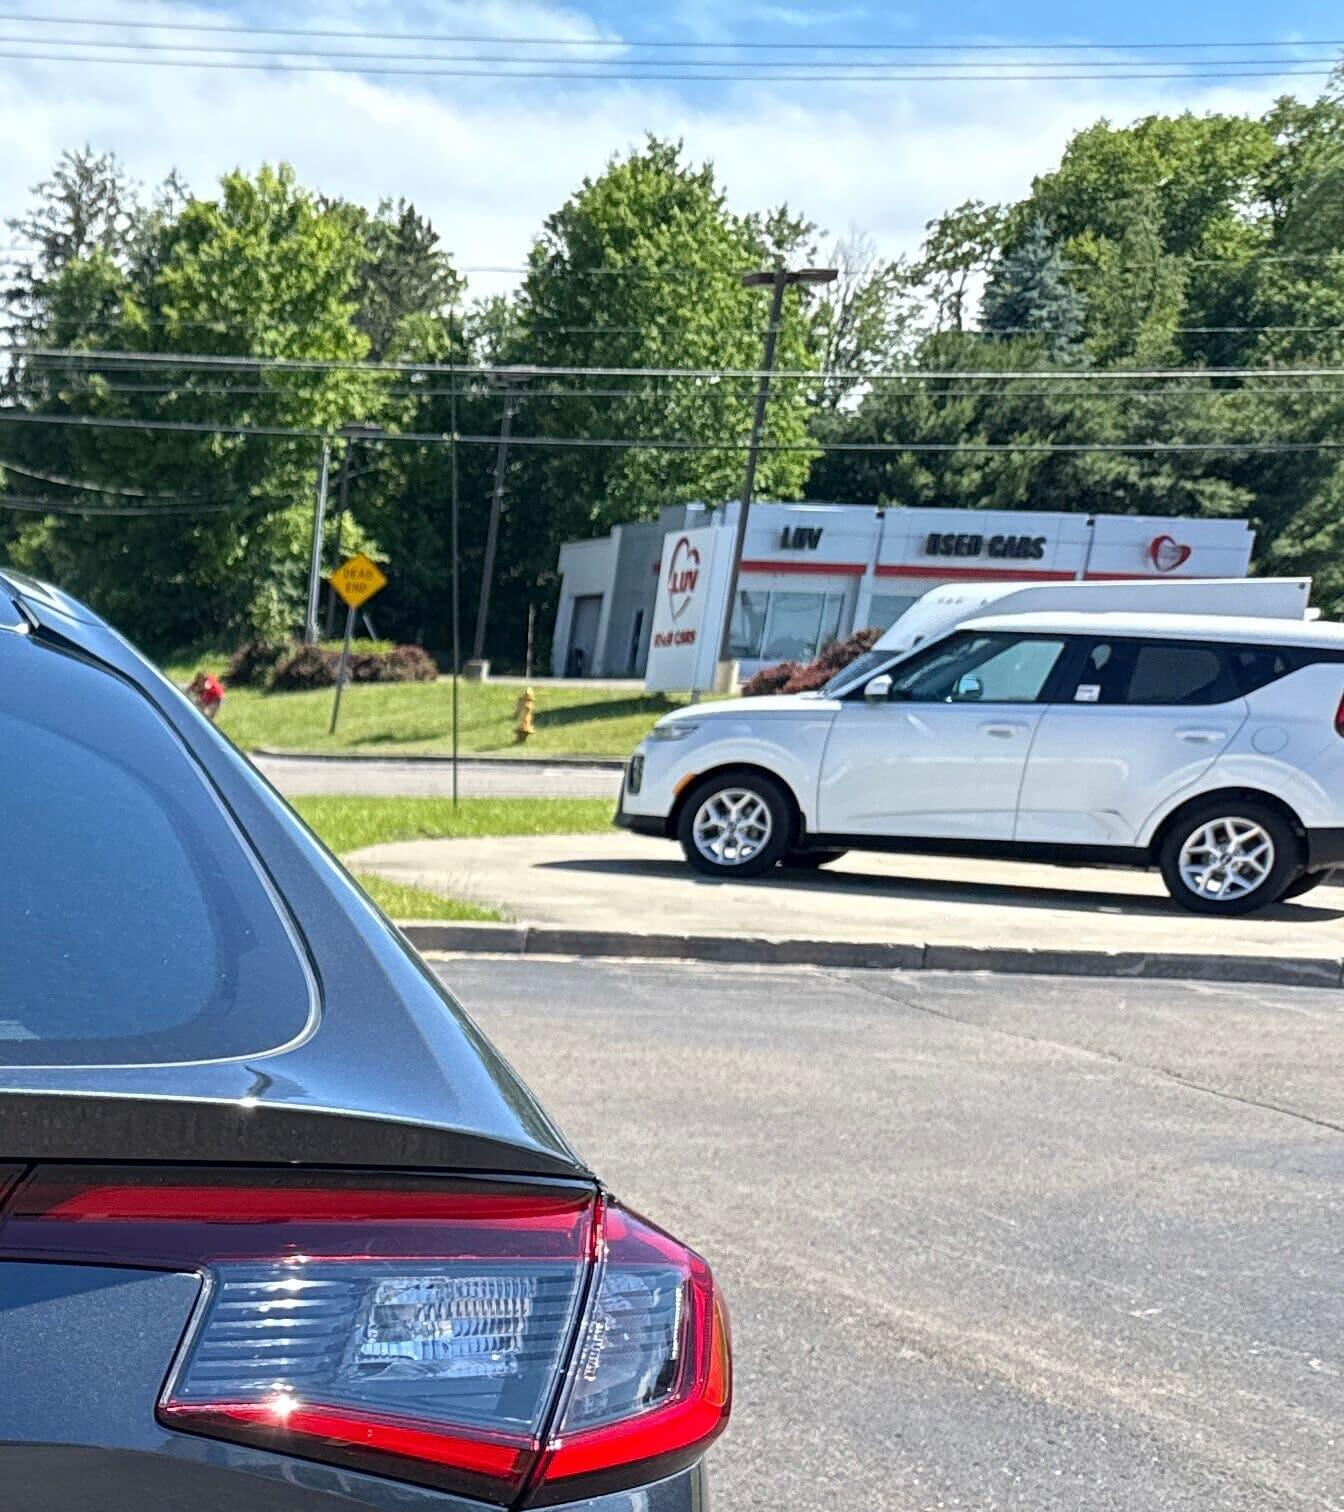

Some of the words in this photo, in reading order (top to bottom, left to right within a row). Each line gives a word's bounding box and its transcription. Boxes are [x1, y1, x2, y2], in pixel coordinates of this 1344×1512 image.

[780, 526, 823, 551] LUV
[924, 532, 983, 557] USED
[988, 535, 1047, 559] CARS
[669, 568, 699, 593] LUV
